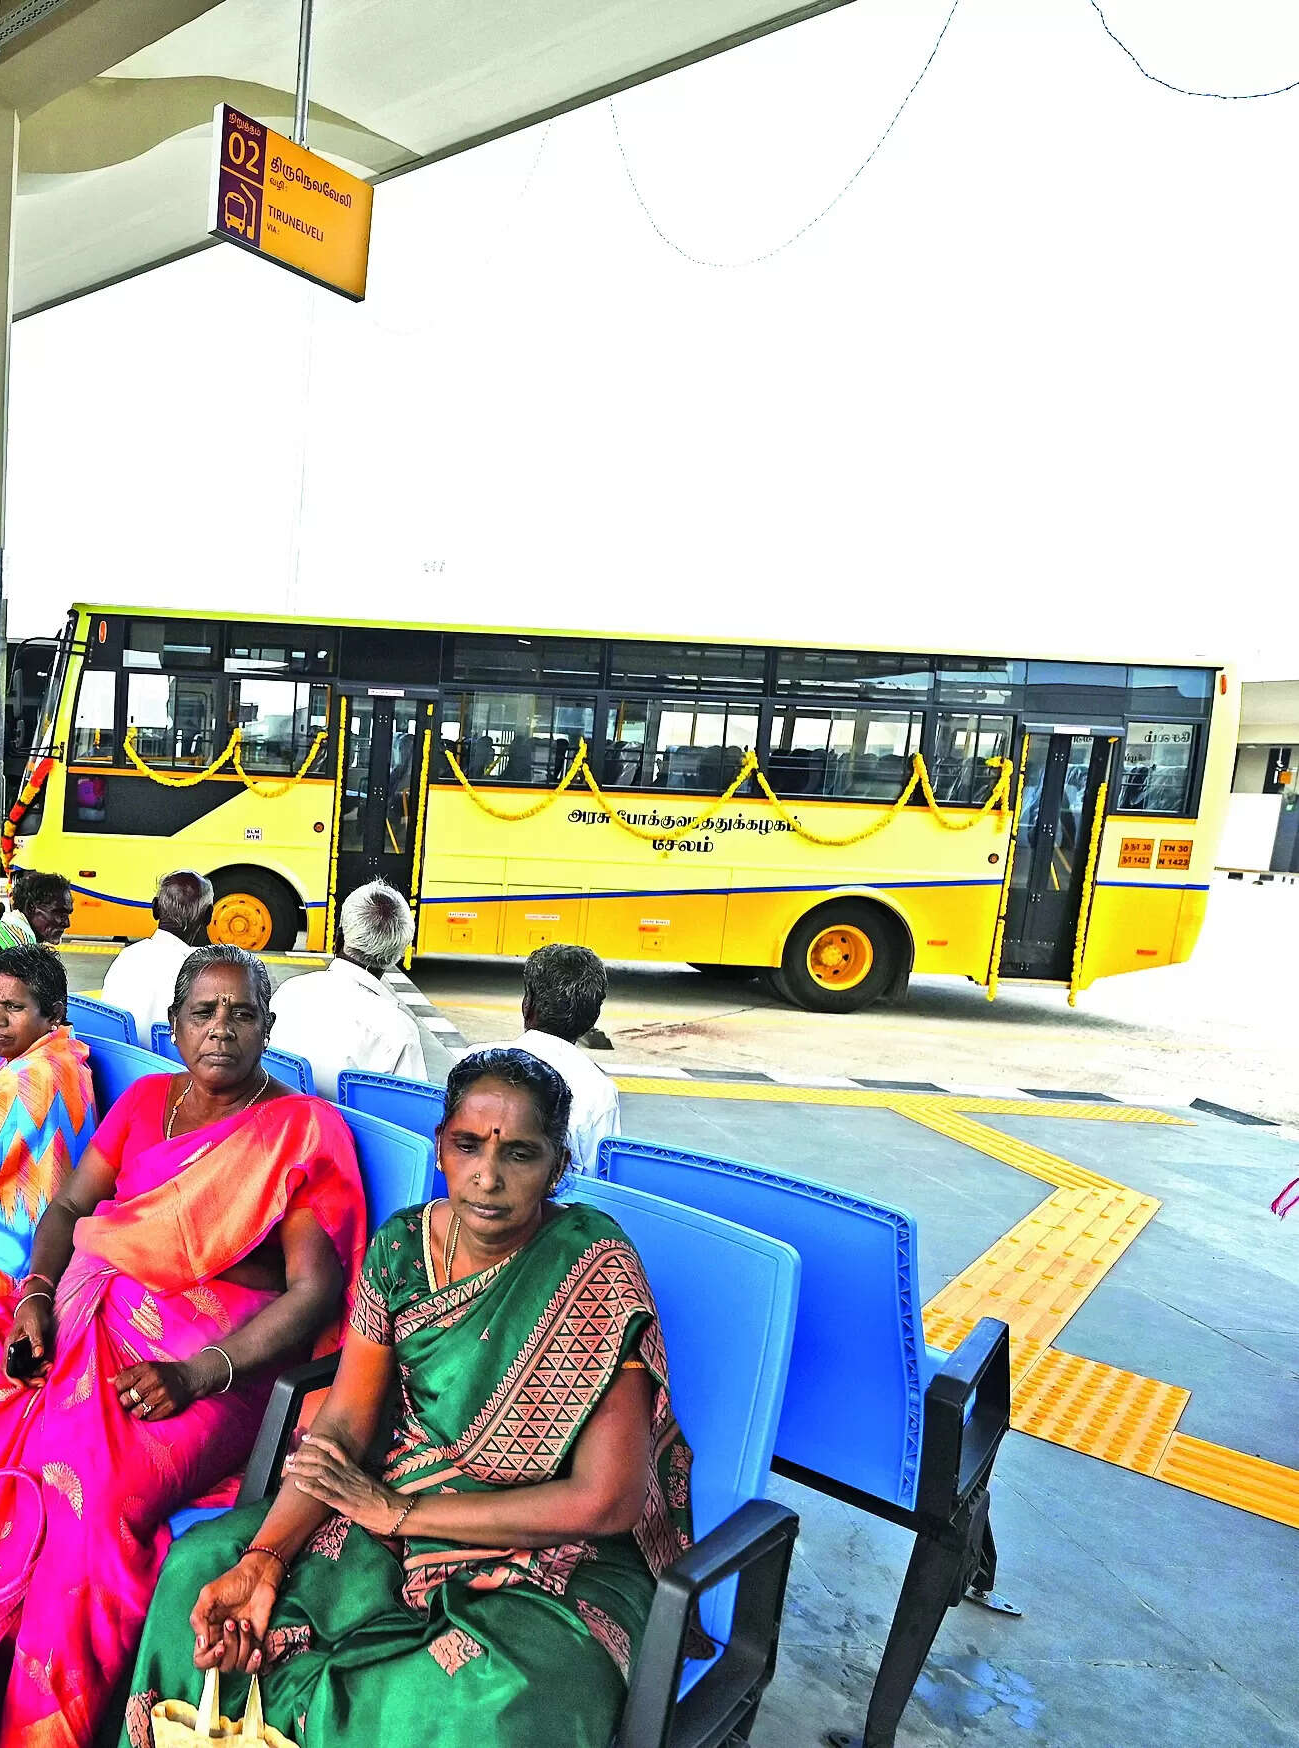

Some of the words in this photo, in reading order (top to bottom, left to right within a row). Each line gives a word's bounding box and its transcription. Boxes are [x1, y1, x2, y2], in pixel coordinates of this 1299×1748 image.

[228, 131, 260, 175] 02
[268, 204, 324, 242] TIRUNELVELI
[1178, 845, 1189, 853] 30
